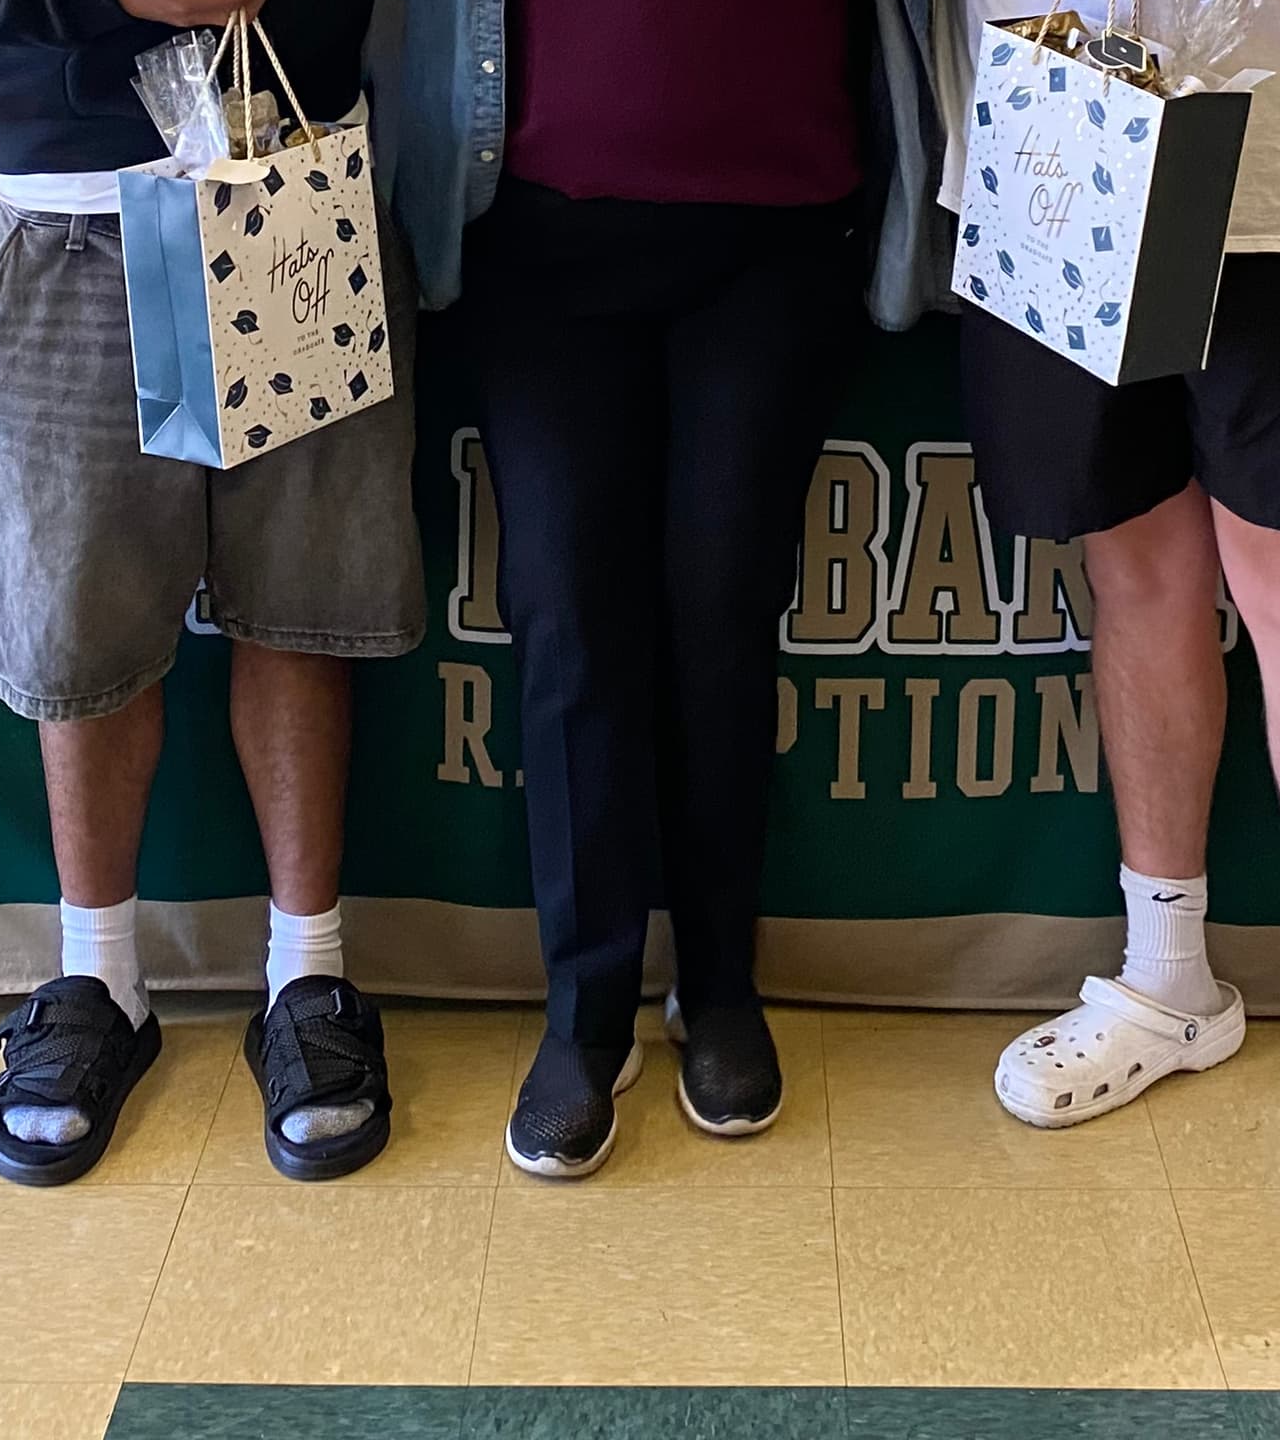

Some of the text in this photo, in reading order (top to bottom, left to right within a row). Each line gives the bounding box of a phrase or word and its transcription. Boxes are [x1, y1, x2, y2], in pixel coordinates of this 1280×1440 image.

[1014, 124, 1069, 179] Hats
[1028, 181, 1084, 239] Off
[267, 227, 319, 294] Hats
[292, 247, 334, 324] Off
